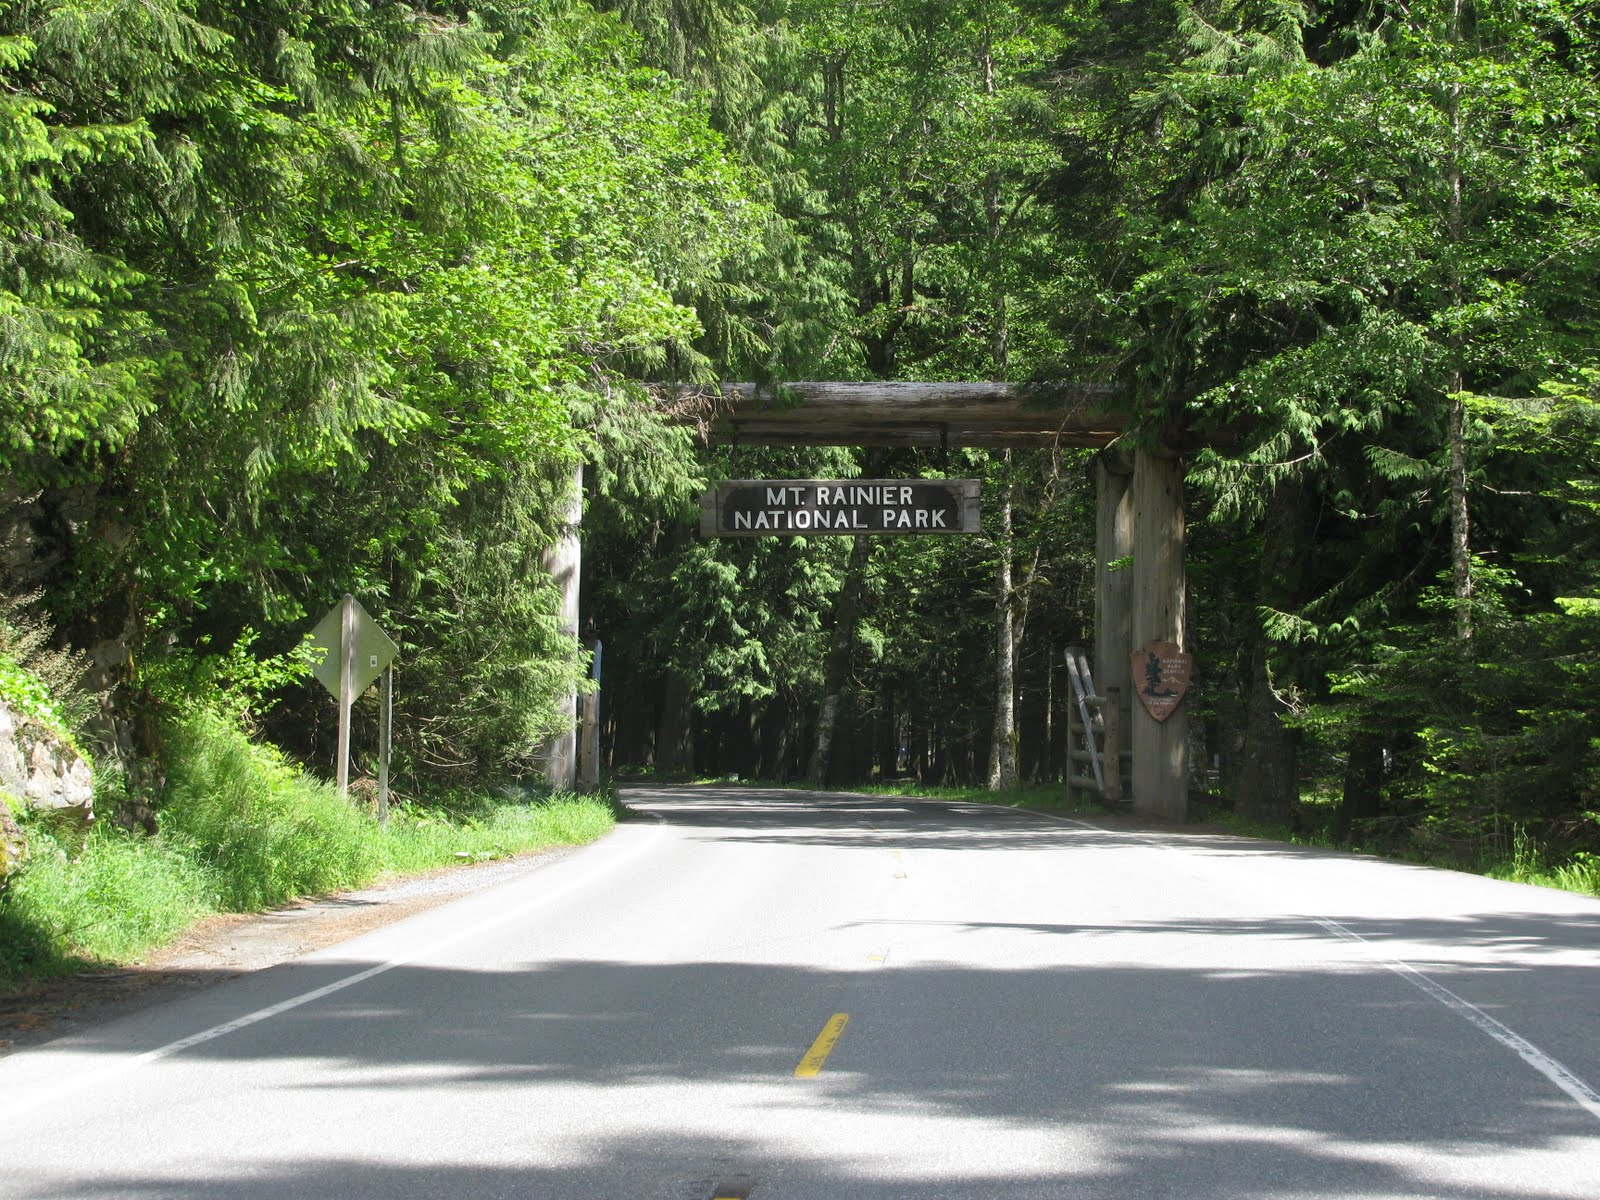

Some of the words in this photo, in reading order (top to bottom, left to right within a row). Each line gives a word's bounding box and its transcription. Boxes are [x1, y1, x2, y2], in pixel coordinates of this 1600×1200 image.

[766, 486, 806, 506] MT.
[817, 486, 913, 506] RAINIER
[734, 510, 868, 529] NATIONAL
[883, 509, 946, 528] PARK
